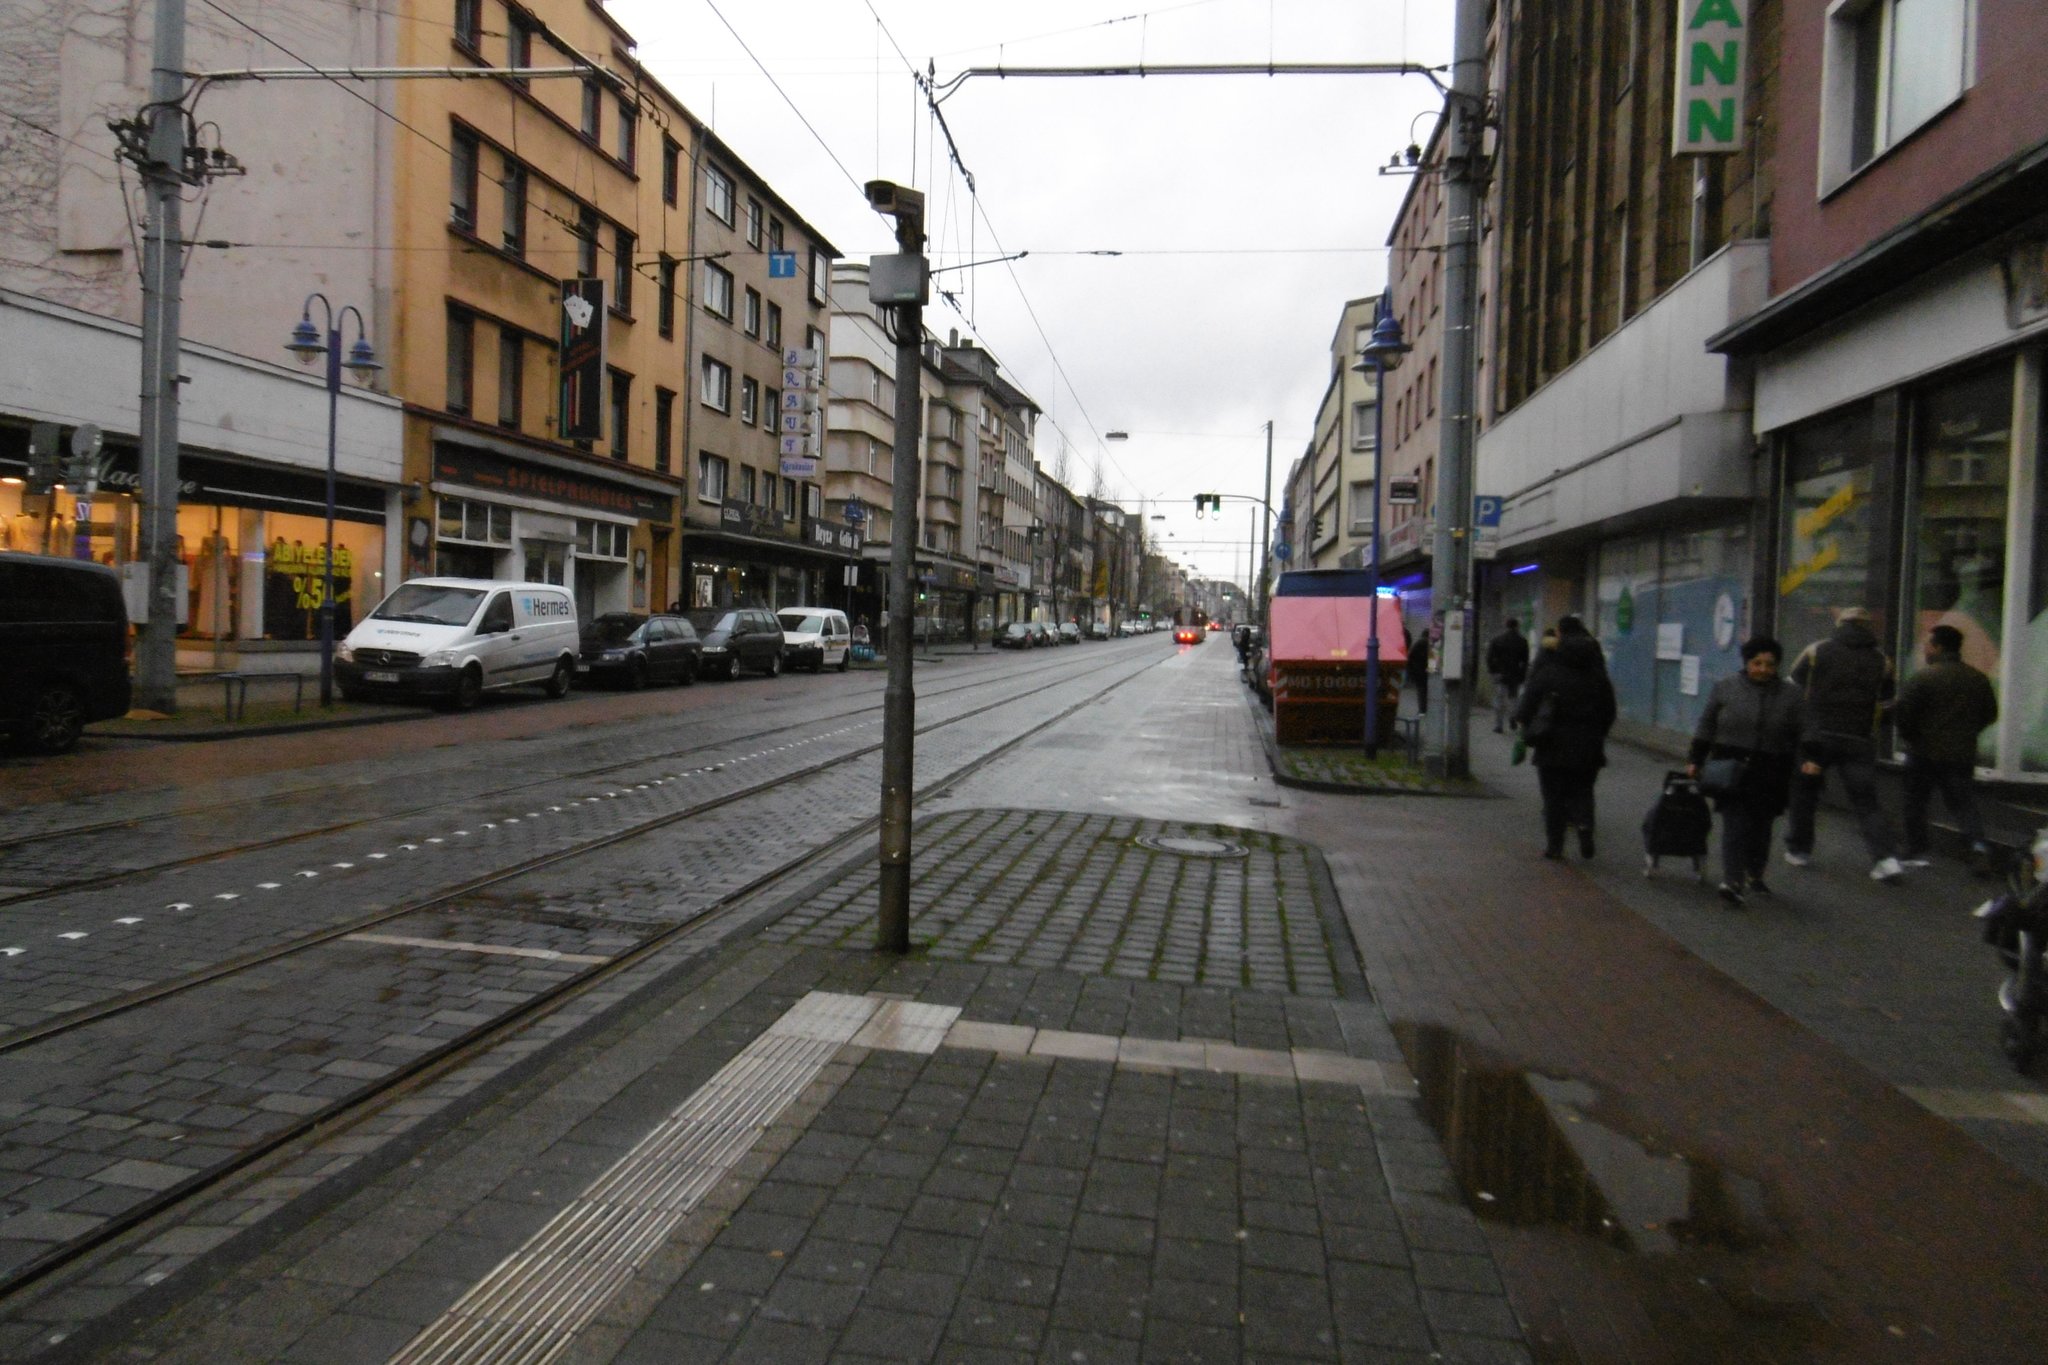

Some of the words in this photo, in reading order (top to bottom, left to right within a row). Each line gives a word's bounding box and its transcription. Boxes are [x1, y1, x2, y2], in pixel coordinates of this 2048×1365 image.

[772, 254, 792, 275] T
[1478, 500, 1496, 525] P
[532, 599, 570, 616] Hermes
